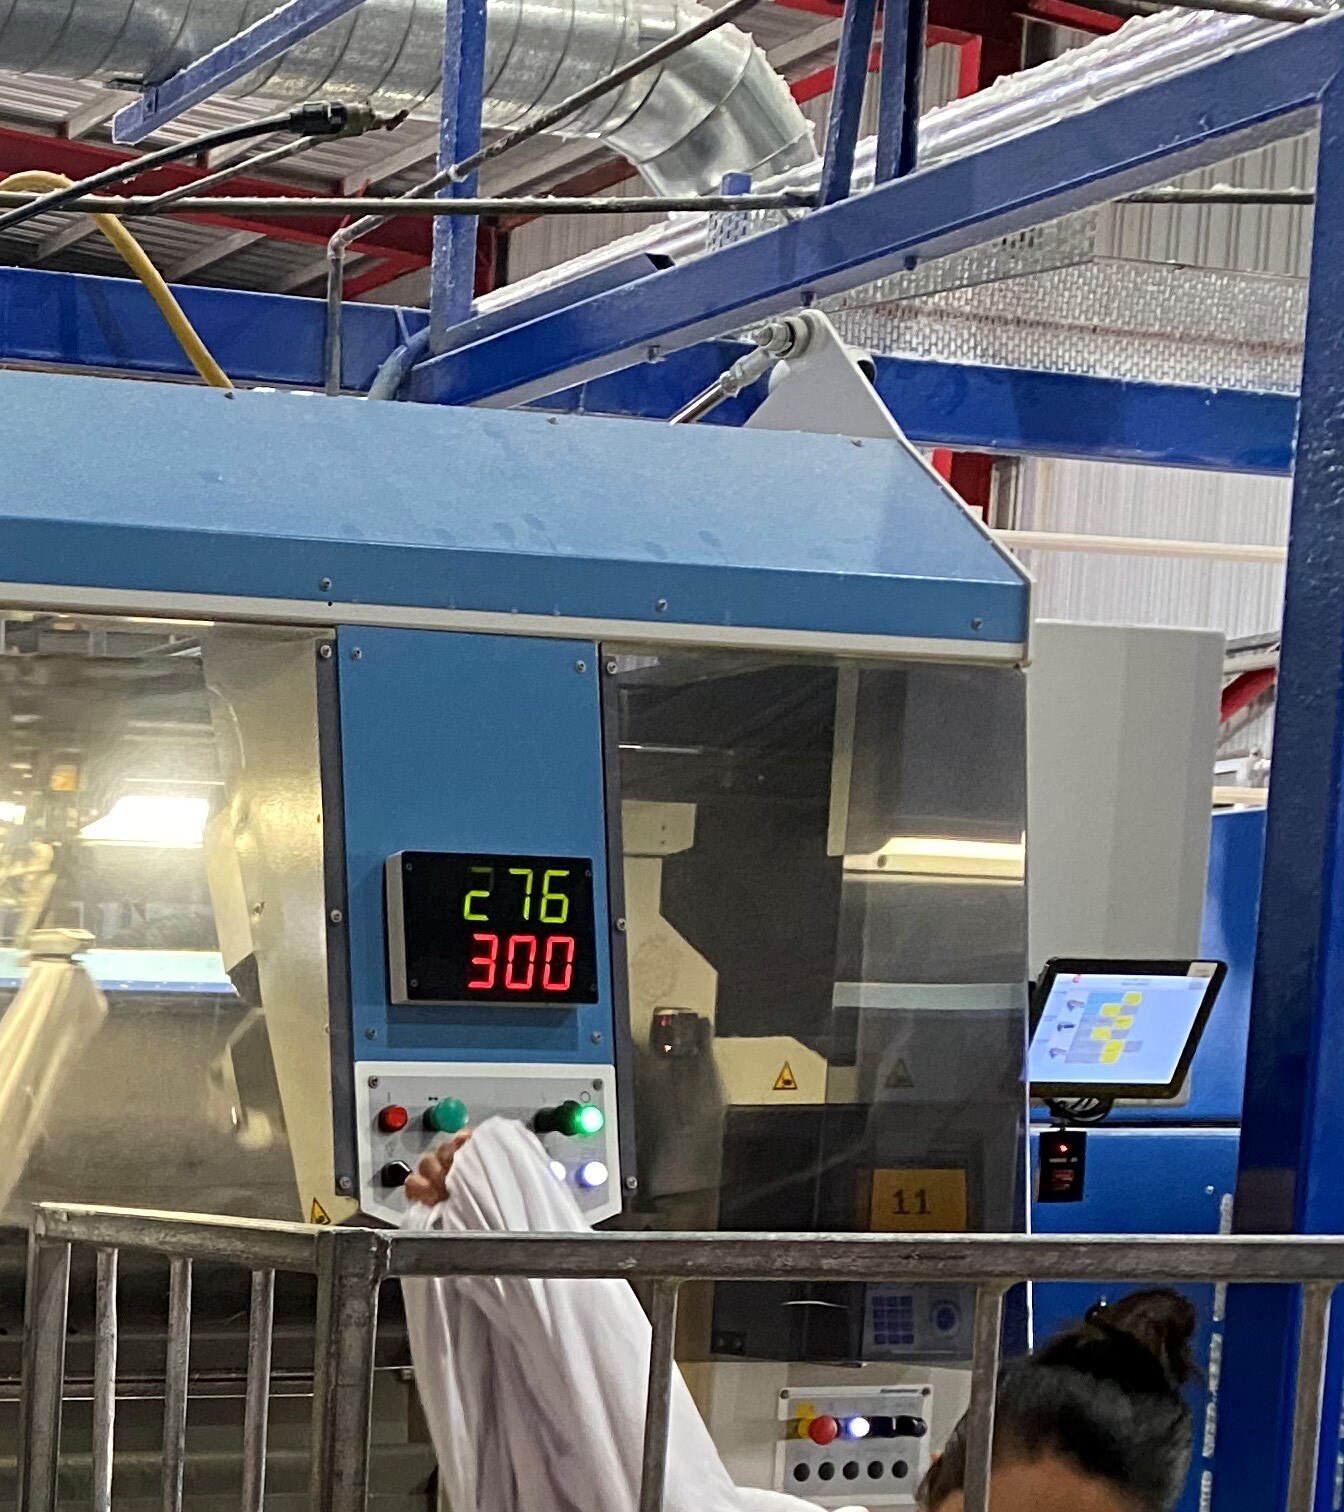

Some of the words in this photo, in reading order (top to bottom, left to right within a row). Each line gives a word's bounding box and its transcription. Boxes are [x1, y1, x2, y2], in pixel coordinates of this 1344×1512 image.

[462, 866, 571, 924] 276
[467, 932, 575, 991] 300
[892, 1188, 932, 1215] 11
